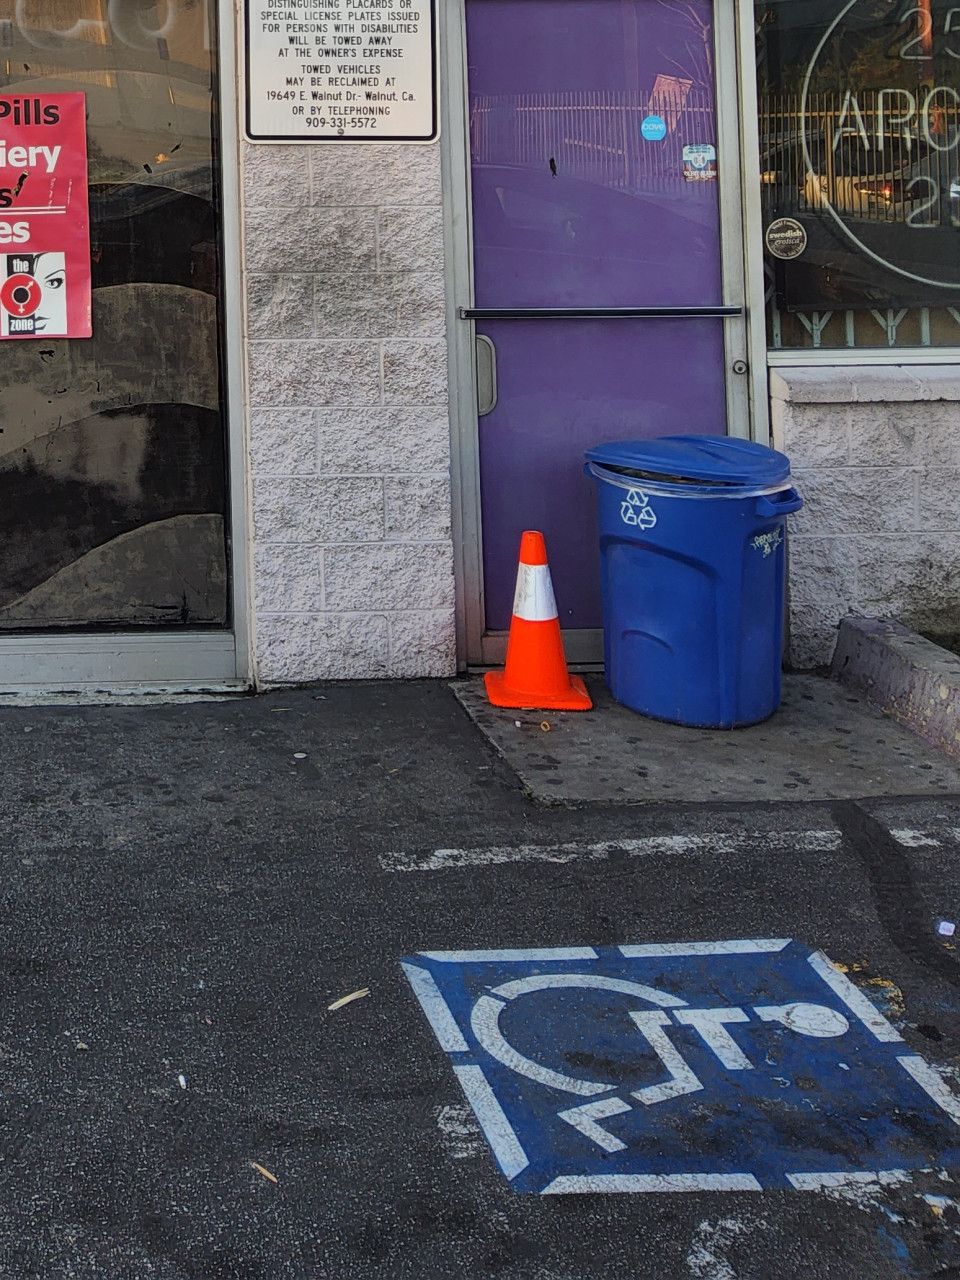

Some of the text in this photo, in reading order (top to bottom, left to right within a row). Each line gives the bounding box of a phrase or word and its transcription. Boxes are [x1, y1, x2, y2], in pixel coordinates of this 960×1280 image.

[268, 0, 411, 8] DISTINGUISHING PLACARDS OR
[261, 12, 420, 21] SPECIAL LICENSE PLATES ISSUED
[263, 24, 418, 33] FOR PERSONS WITH DISABILITIES
[289, 36, 392, 45] WILL BE TOWED AWAY
[279, 49, 403, 57] AT THE OWNER'S EXPENSE
[302, 65, 380, 74] TOWED VEHICLES
[286, 77, 395, 86] MAY BE RECLAIMED AT
[267, 91, 295, 100] 19649
[300, 91, 308, 100] E.
[312, 91, 342, 100] Walnut
[402, 92, 415, 101] Ca.
[292, 106, 390, 115] OR BY TELEPHONING
[306, 118, 376, 128] 909-331-5572
[906, 176, 960, 228] 2
[769, 230, 802, 239] swedish
[12, 259, 29, 272] the
[10, 319, 34, 331] zone
